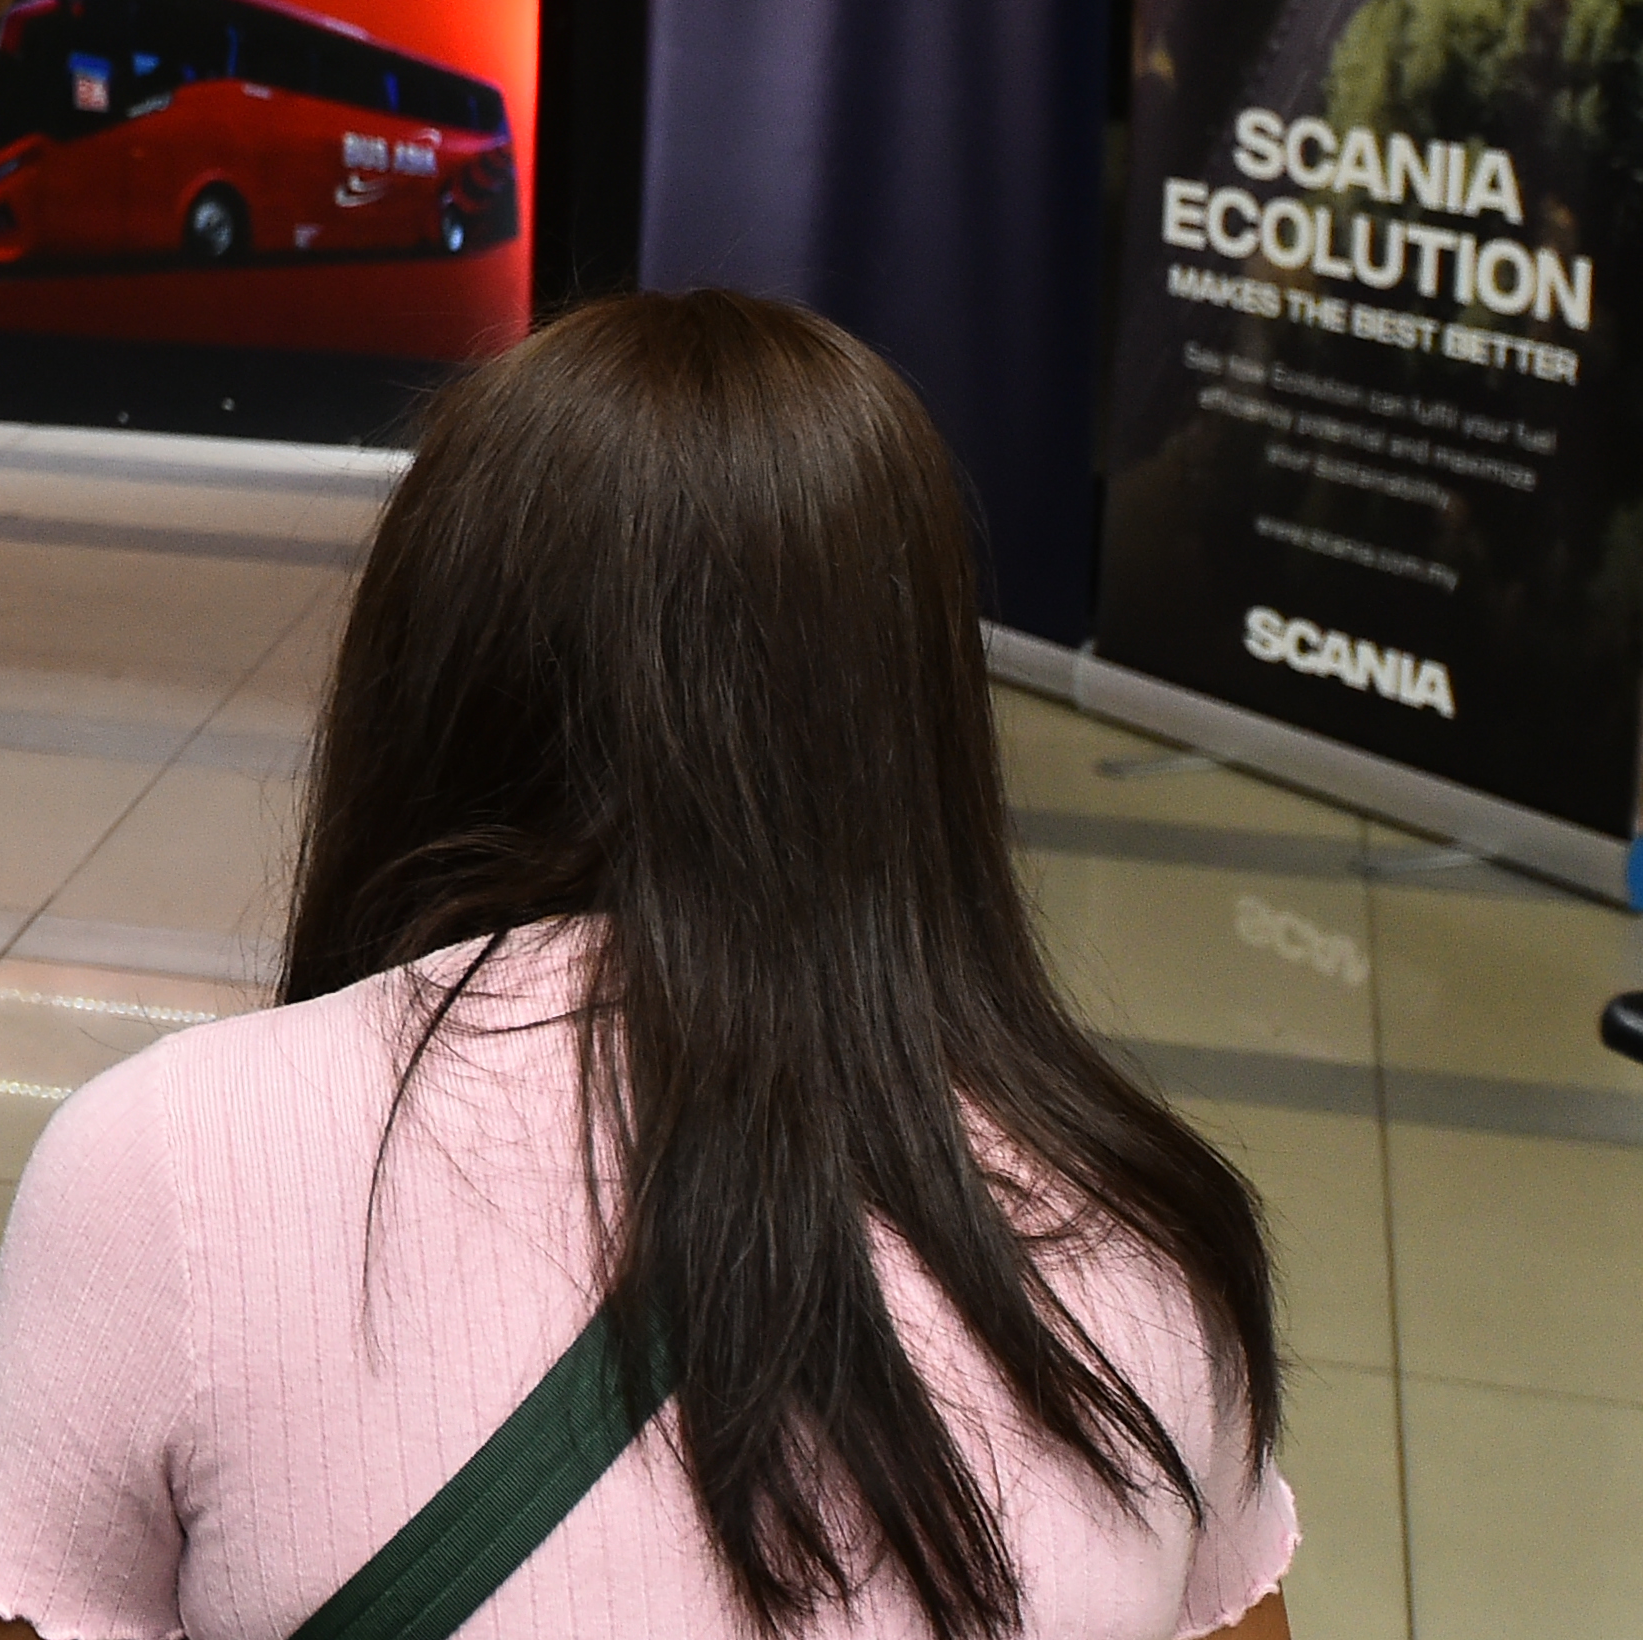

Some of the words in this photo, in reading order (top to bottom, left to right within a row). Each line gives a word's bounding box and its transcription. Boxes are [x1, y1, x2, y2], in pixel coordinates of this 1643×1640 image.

[1233, 106, 1523, 225] SCANIA
[1162, 176, 1594, 332] ECOLUTION
[1168, 264, 1281, 318] MAKES
[1284, 289, 1348, 334] THE
[1350, 303, 1441, 354] BEST
[1442, 322, 1579, 387] BETTER
[1243, 604, 1457, 719] SCANIA
